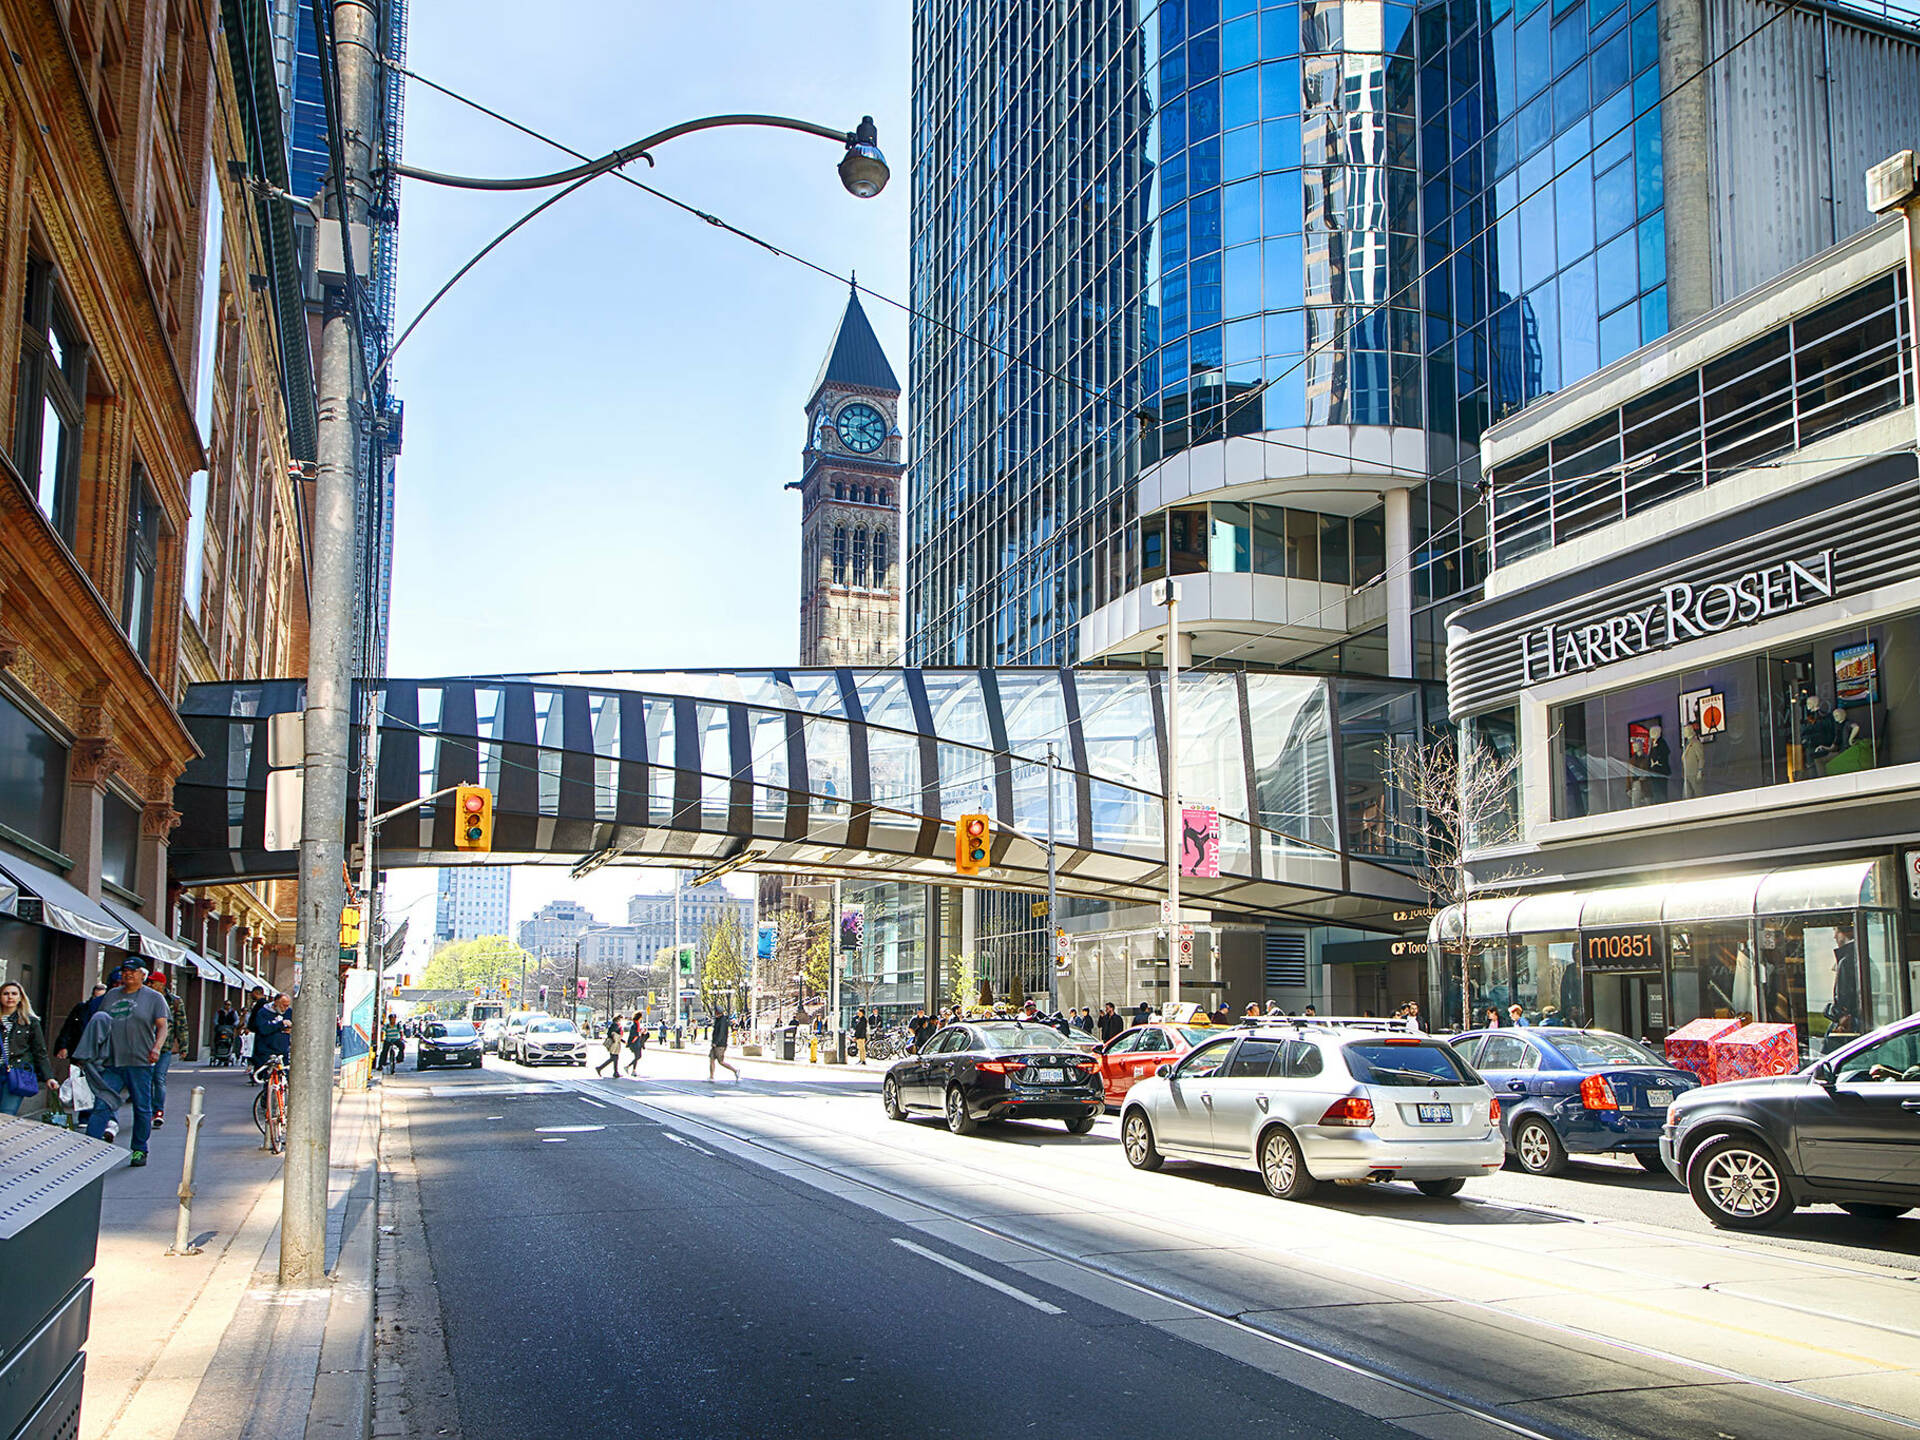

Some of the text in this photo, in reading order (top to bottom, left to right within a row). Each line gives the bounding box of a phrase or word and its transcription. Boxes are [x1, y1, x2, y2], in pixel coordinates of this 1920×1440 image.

[1518, 548, 1838, 687] HARRY ROSEN
[1208, 812, 1220, 879] THE ARTS
[856, 912, 865, 952] GROOVE
[1588, 934, 1652, 959] m0851
